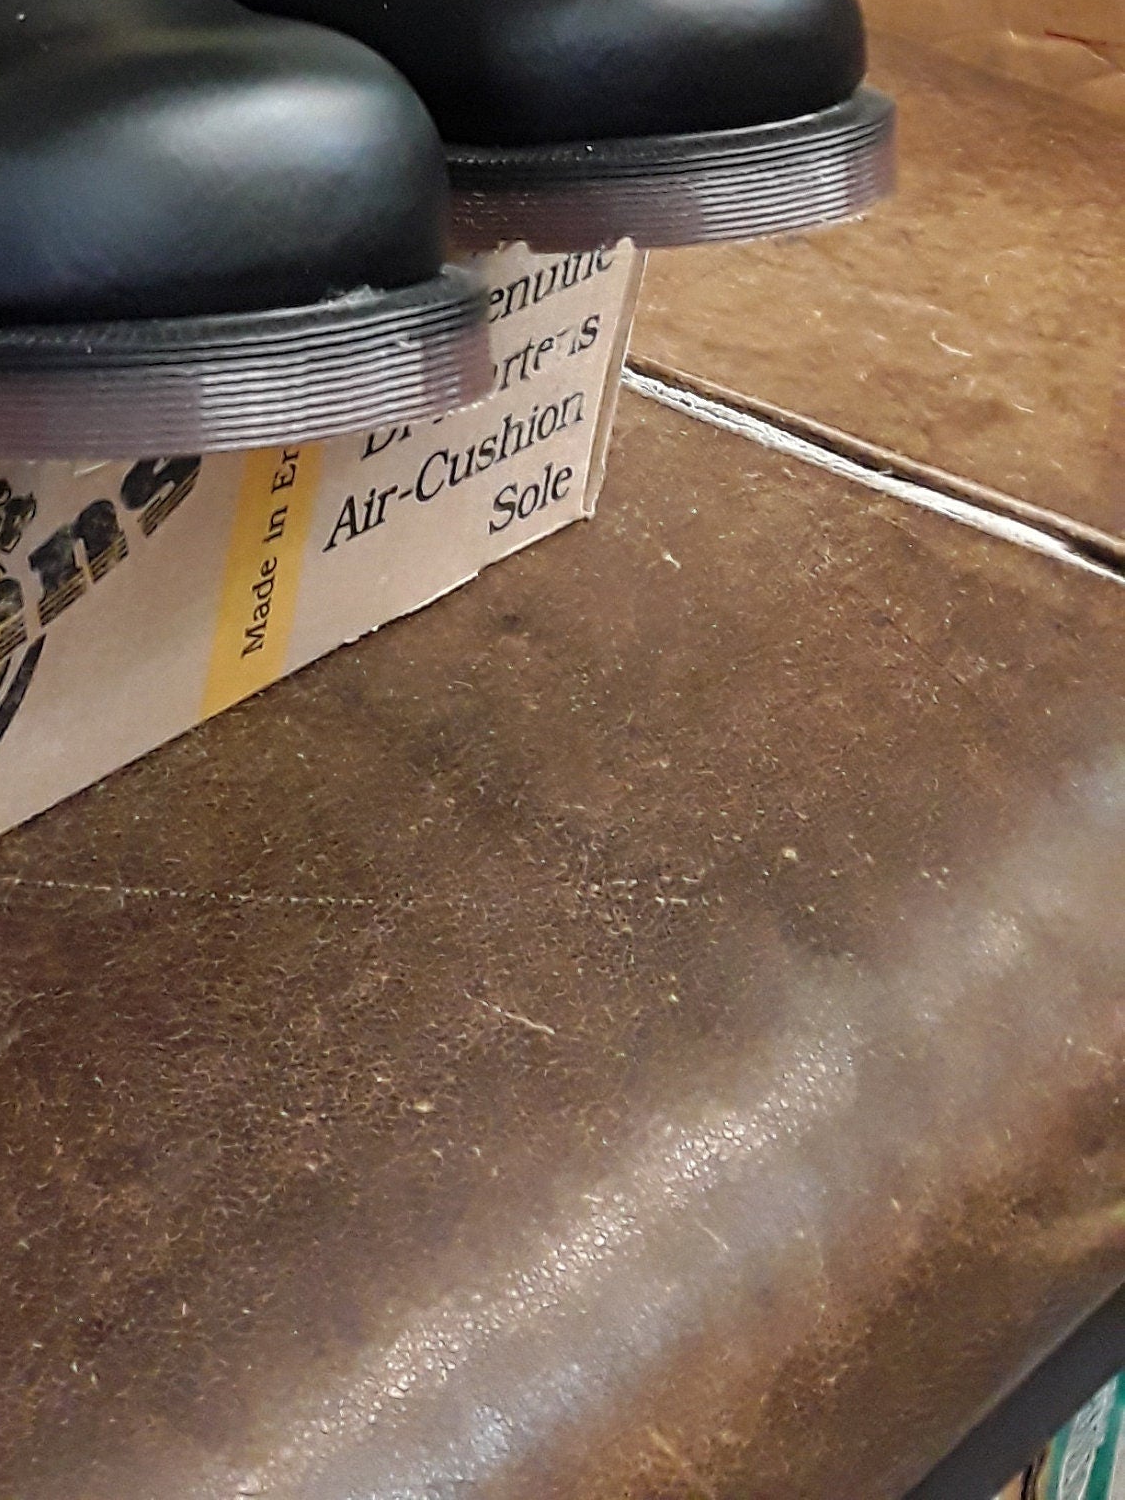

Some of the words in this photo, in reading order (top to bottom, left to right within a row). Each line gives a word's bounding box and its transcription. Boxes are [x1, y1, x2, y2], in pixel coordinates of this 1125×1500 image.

[488, 247, 616, 325] enuine
[321, 390, 586, 554] Air-Cushion
[487, 462, 575, 537] Sole
[240, 556, 279, 661] Made
[261, 504, 290, 545] in
